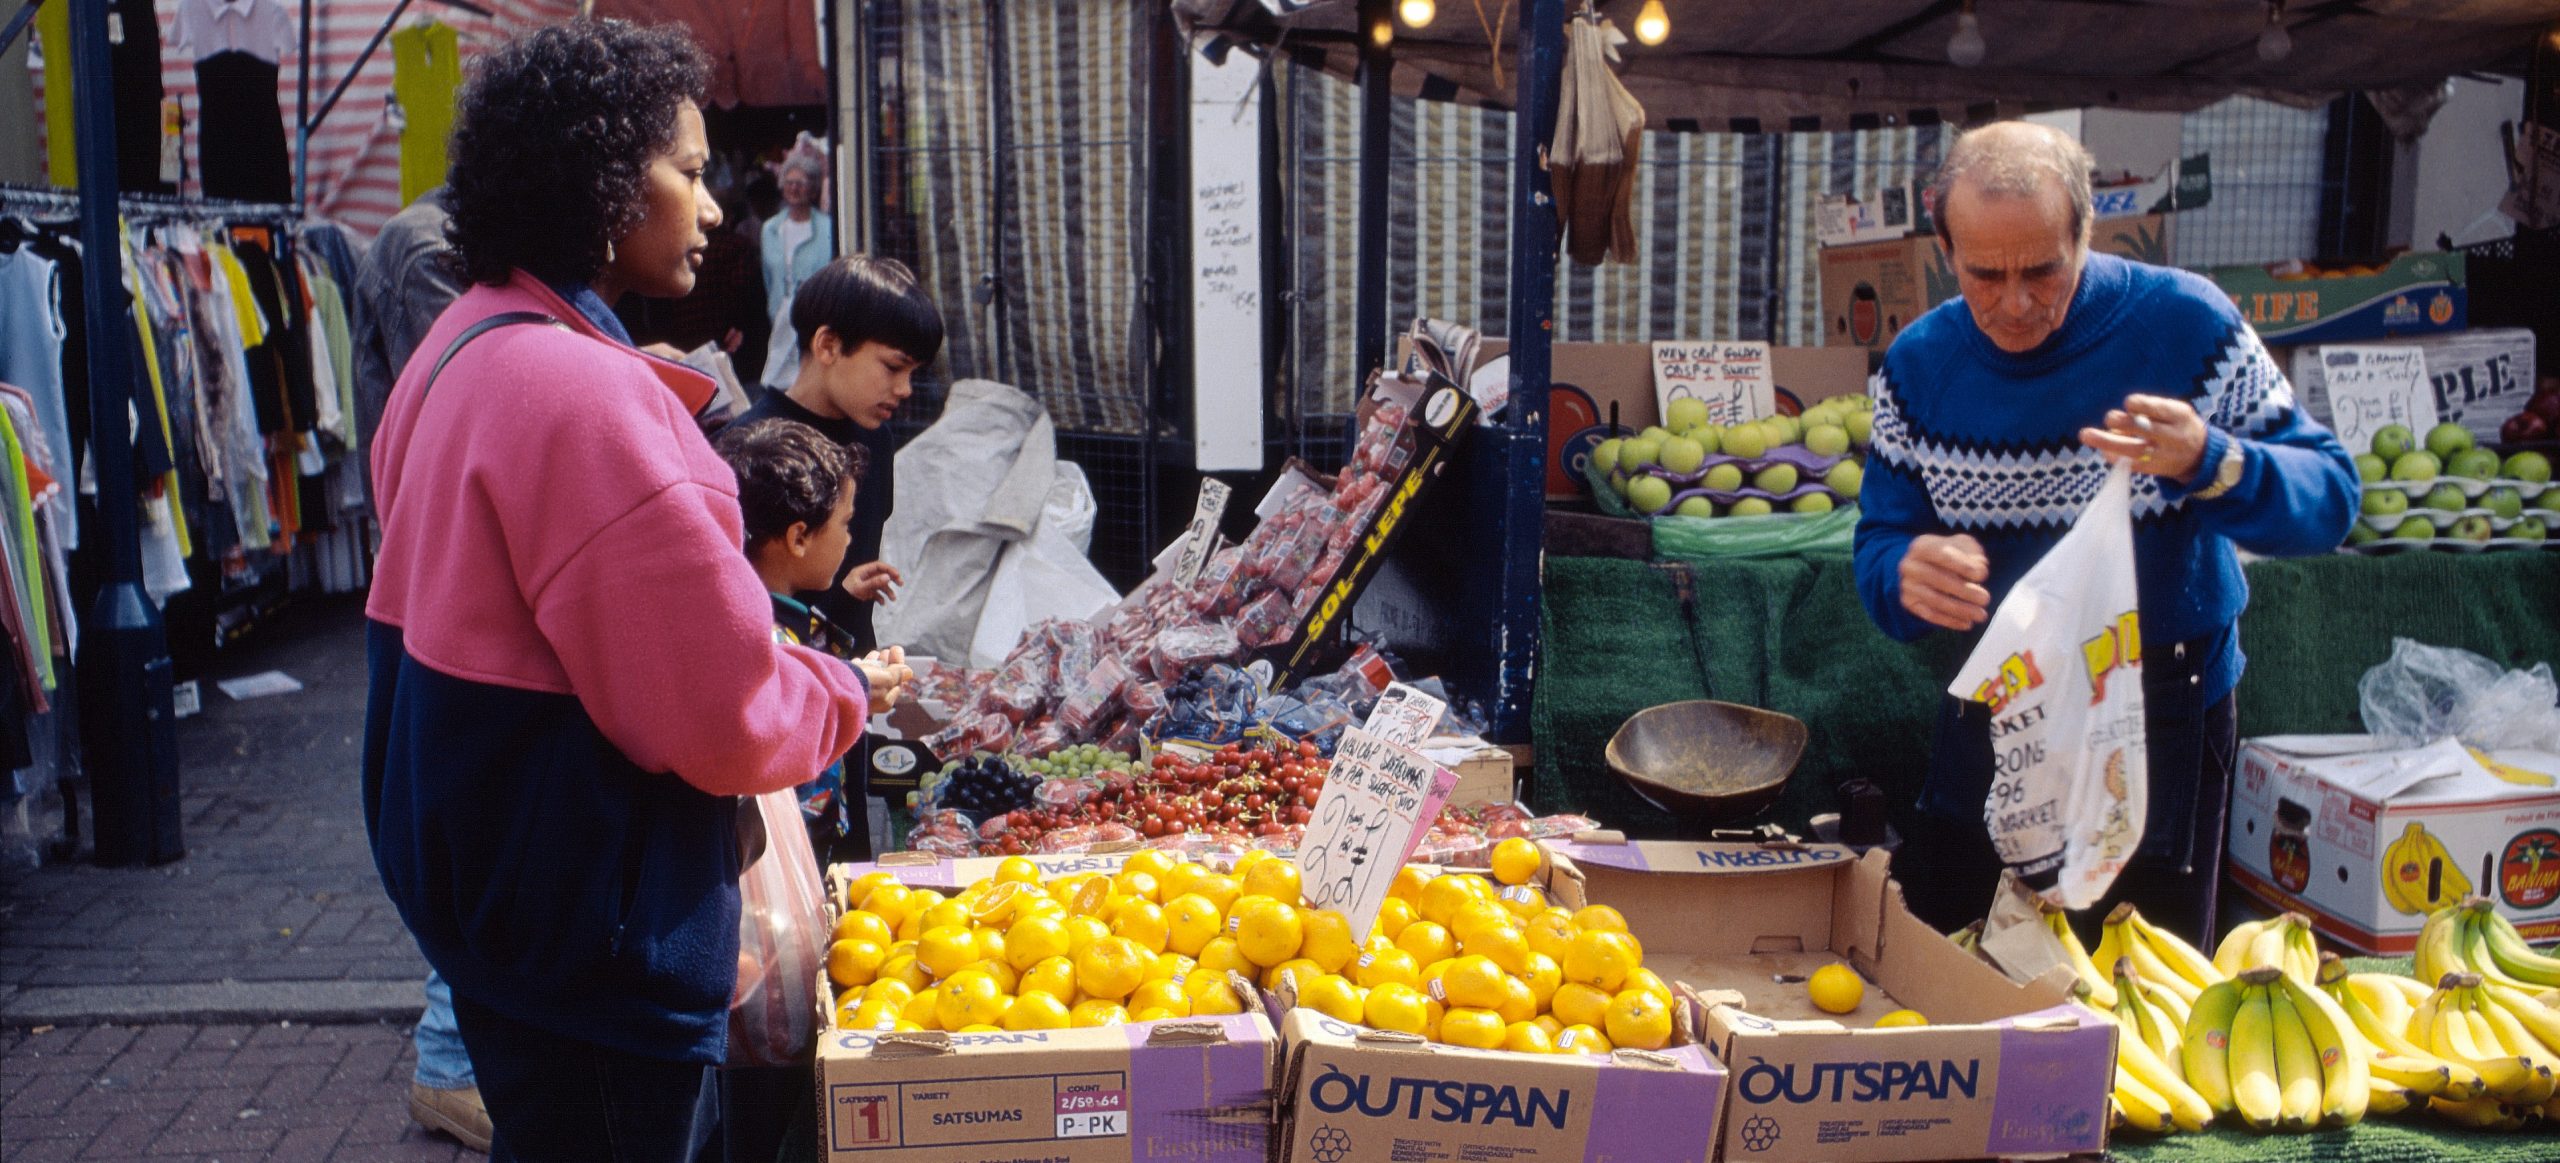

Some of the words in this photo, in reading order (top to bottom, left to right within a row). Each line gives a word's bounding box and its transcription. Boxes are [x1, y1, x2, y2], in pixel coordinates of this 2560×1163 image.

[1659, 347, 1687, 358] NEW
[1691, 343, 1718, 359] CROP
[1664, 363, 1700, 377] CRISP
[1721, 363, 1761, 375] SWEET
[2432, 352, 2516, 412] PLE
[1307, 579, 1355, 642] SOL
[1363, 466, 1424, 556] LEPE
[911, 1091, 950, 1101] VARIETY
[1066, 1084, 1101, 1093] COUNT
[838, 1094, 888, 1105] CATEGORY
[858, 1101, 882, 1140] 1
[932, 1108, 1023, 1126] SATSUMAS
